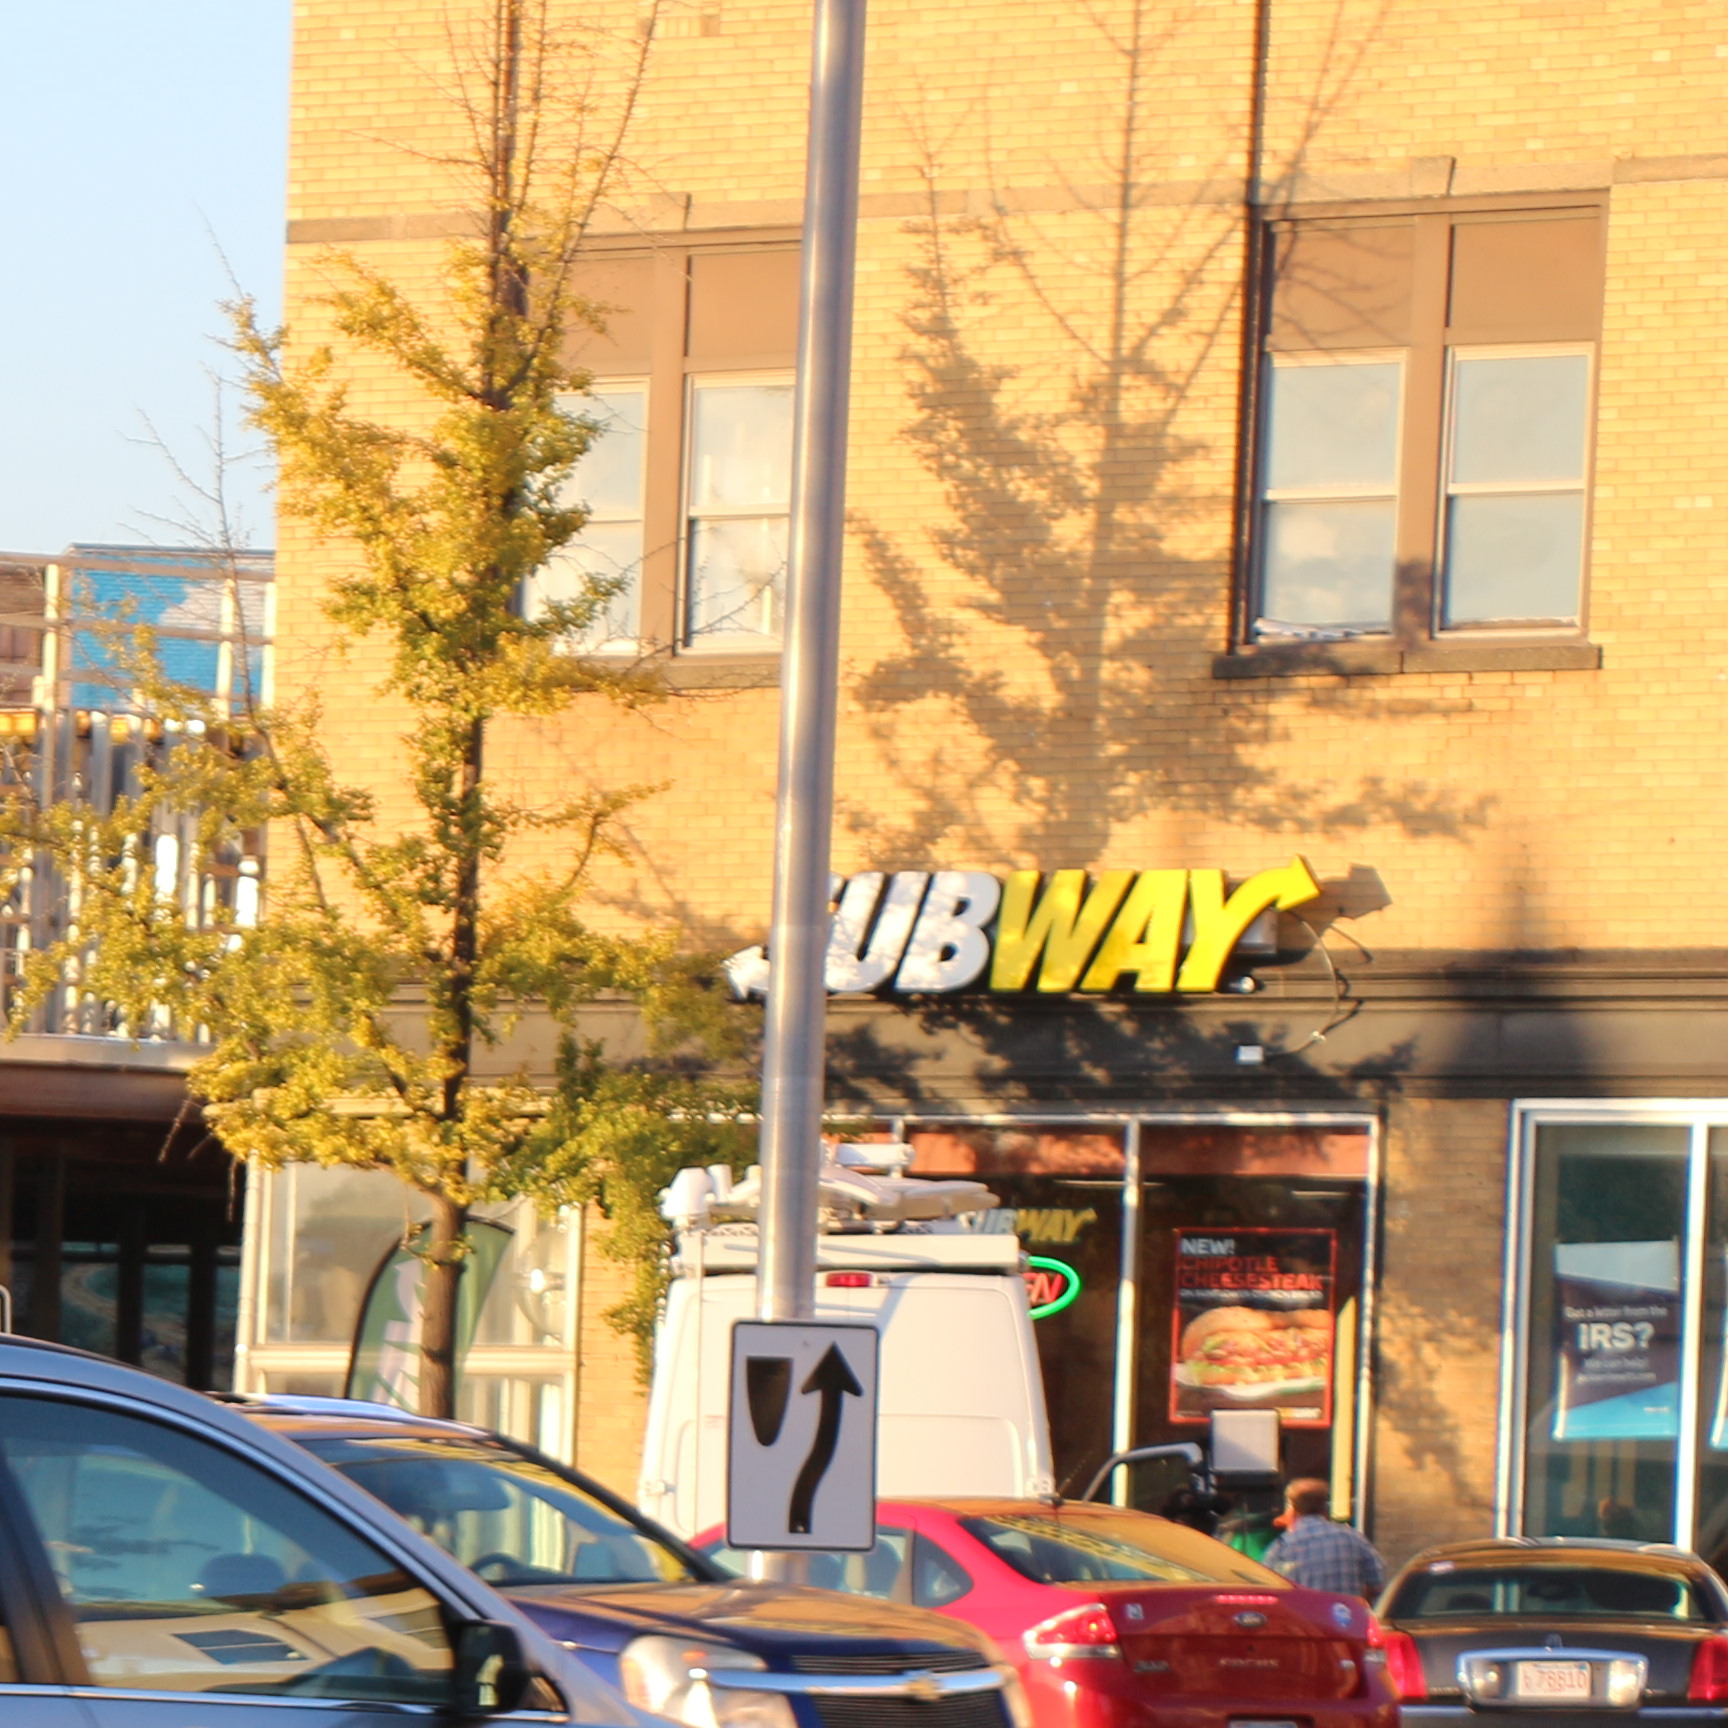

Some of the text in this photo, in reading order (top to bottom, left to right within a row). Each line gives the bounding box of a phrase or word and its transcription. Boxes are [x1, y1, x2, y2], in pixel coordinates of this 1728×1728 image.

[1180, 1237, 1236, 1256] NEW!
[1180, 1255, 1280, 1273] CHIPOTLE
[1180, 1272, 1325, 1291] CHEESESTEAK
[1578, 1320, 1655, 1350] IRS?
